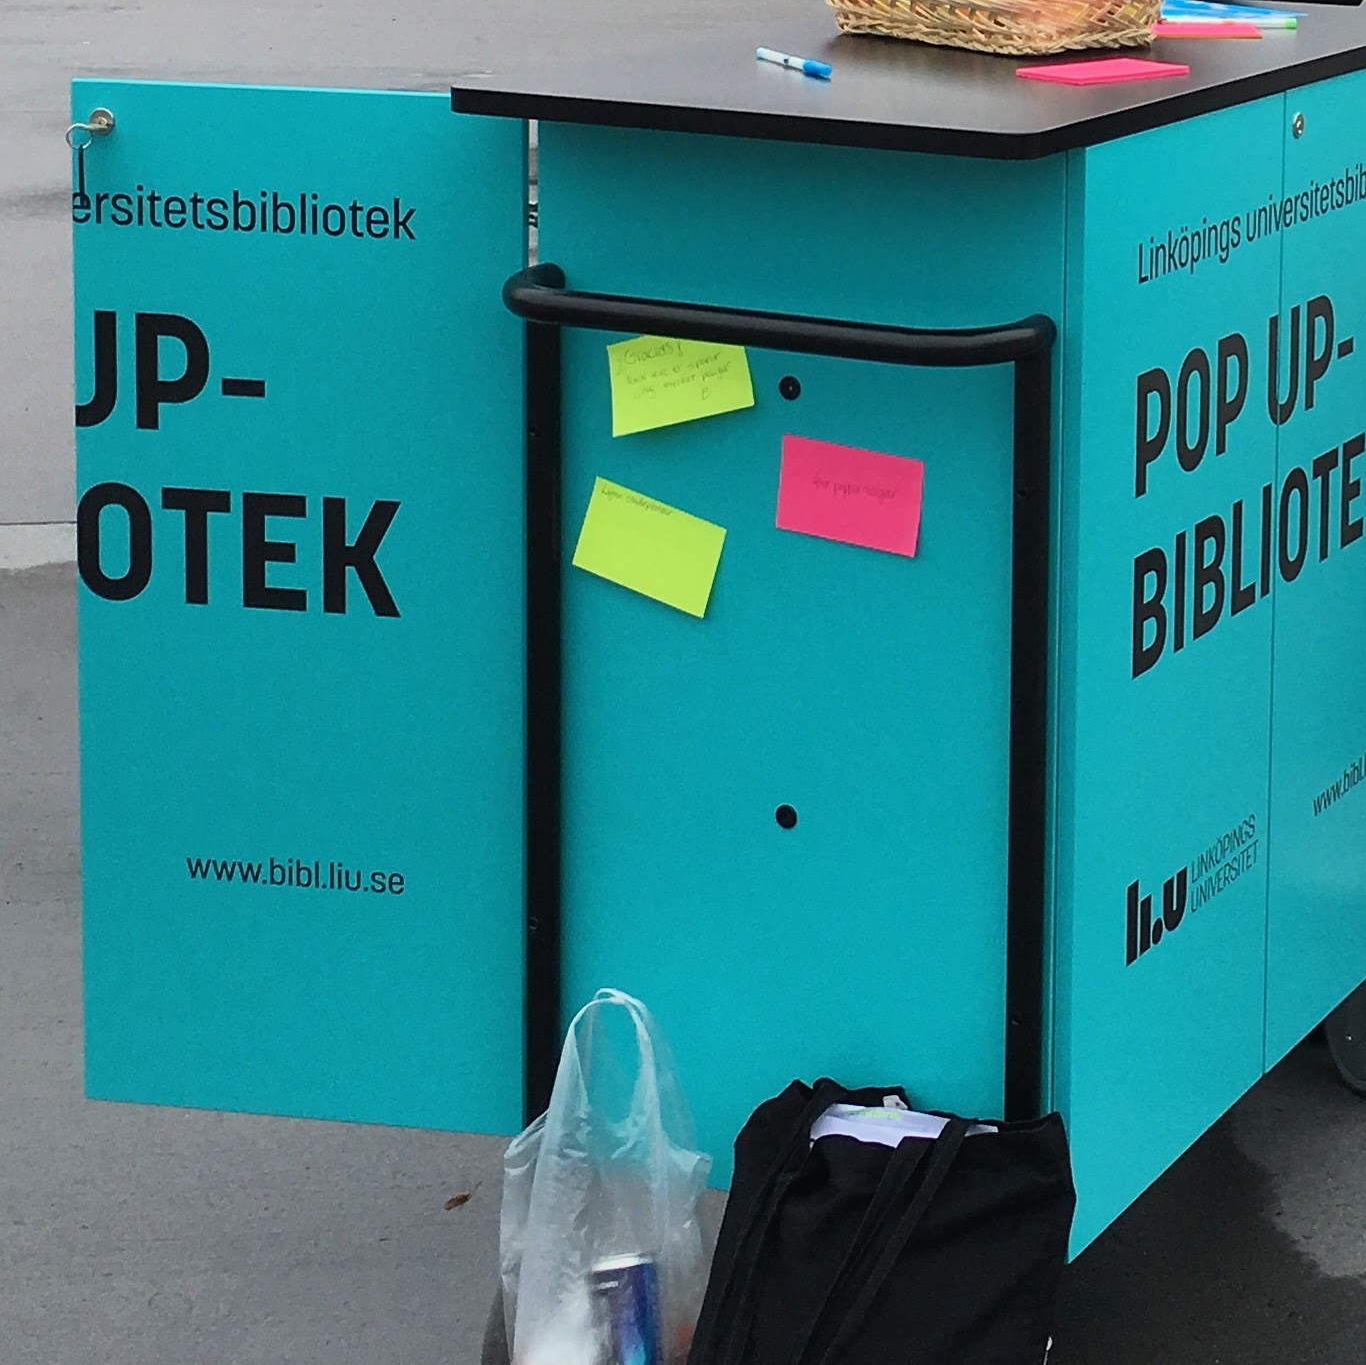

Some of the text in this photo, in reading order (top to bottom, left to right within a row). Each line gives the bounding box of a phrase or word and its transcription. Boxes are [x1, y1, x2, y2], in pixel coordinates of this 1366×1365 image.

[72, 184, 416, 240] ersitetsbibliotek
[1137, 216, 1241, 285] Linköpings
[1134, 294, 1355, 499] POP UP-
[75, 482, 401, 618] OTEK
[186, 857, 405, 895] www.bibl.liu.se
[1190, 839, 1259, 913] UNIVERSITET
[1191, 813, 1256, 884] LINKÖPINGS
